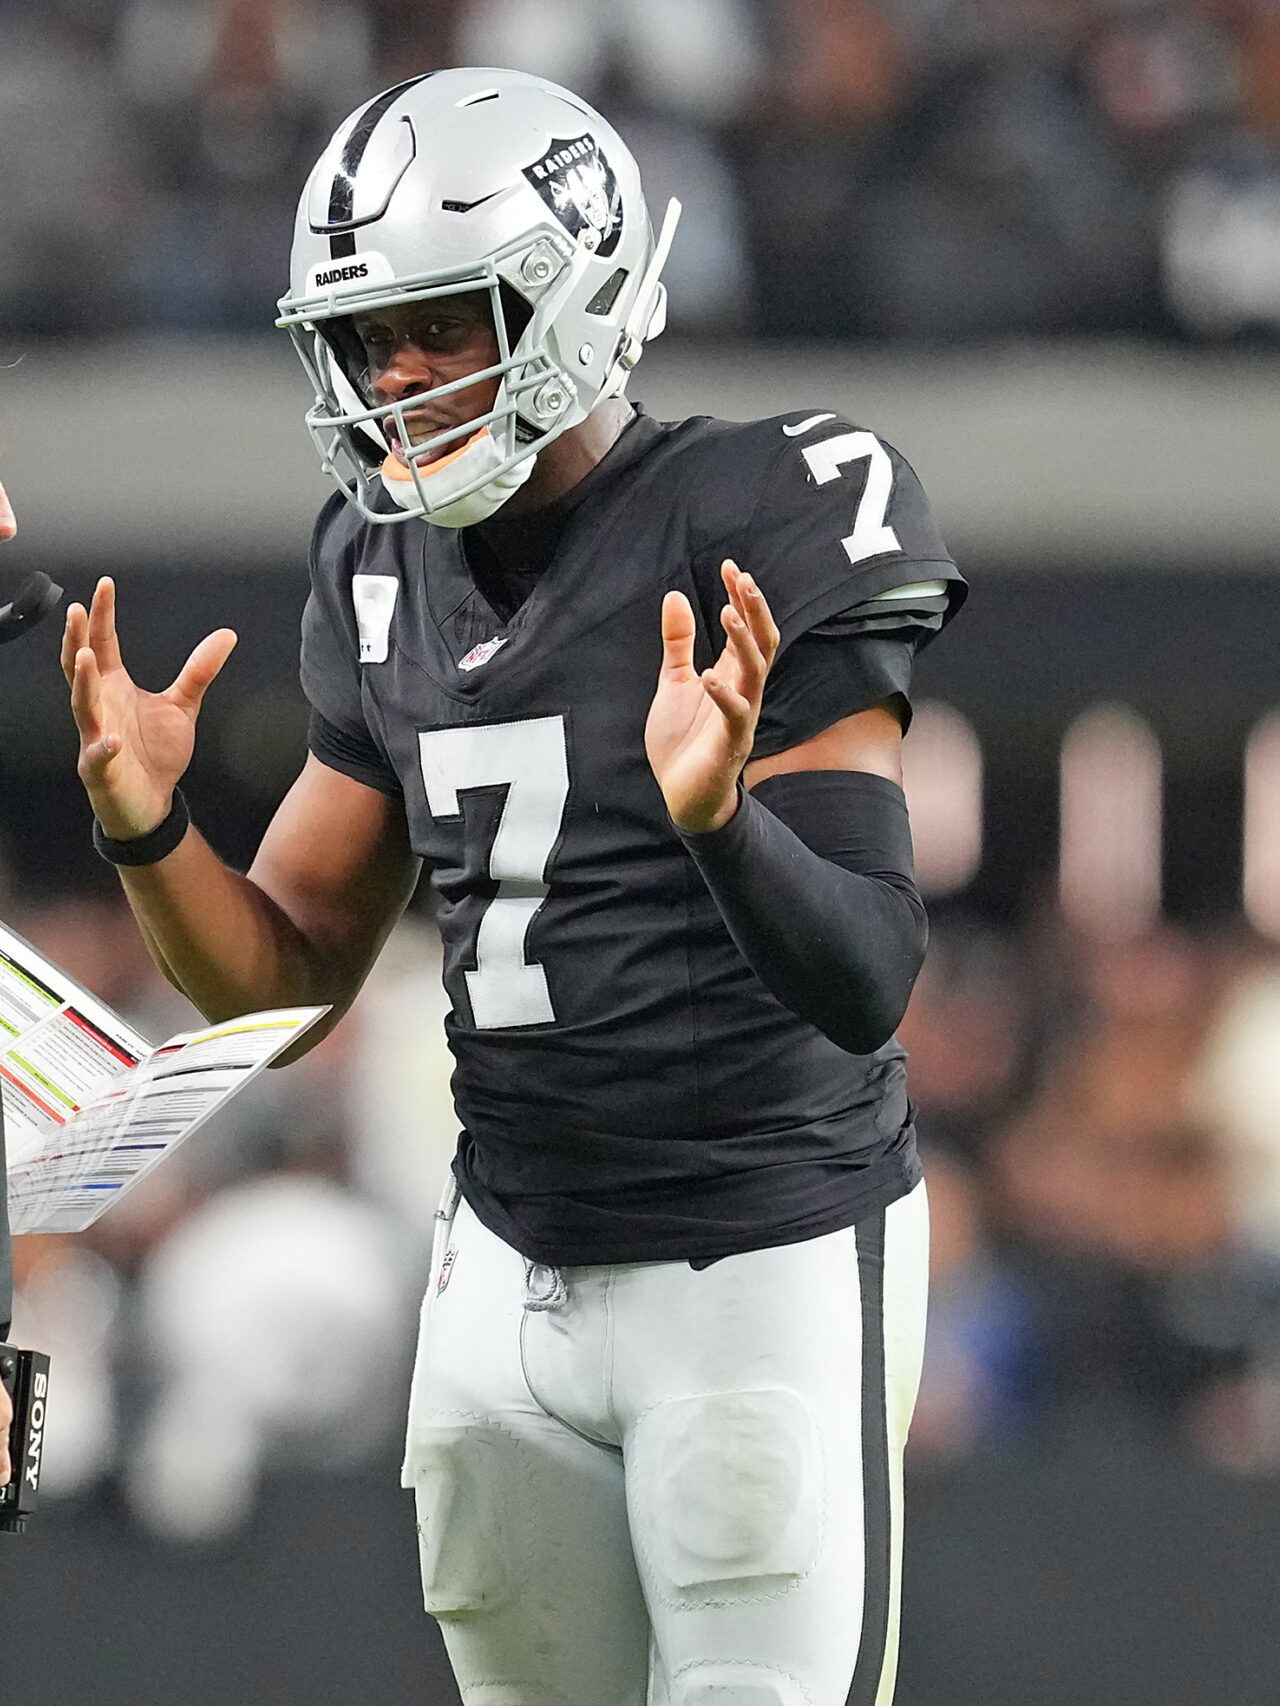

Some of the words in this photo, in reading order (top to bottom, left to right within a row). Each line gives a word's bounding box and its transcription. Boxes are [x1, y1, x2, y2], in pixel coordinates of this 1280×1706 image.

[532, 137, 595, 180] RAIDERS
[315, 263, 368, 287] RAIDERS
[801, 431, 903, 565] 7
[418, 715, 570, 1031] 7
[25, 1372, 48, 1491] SONY
